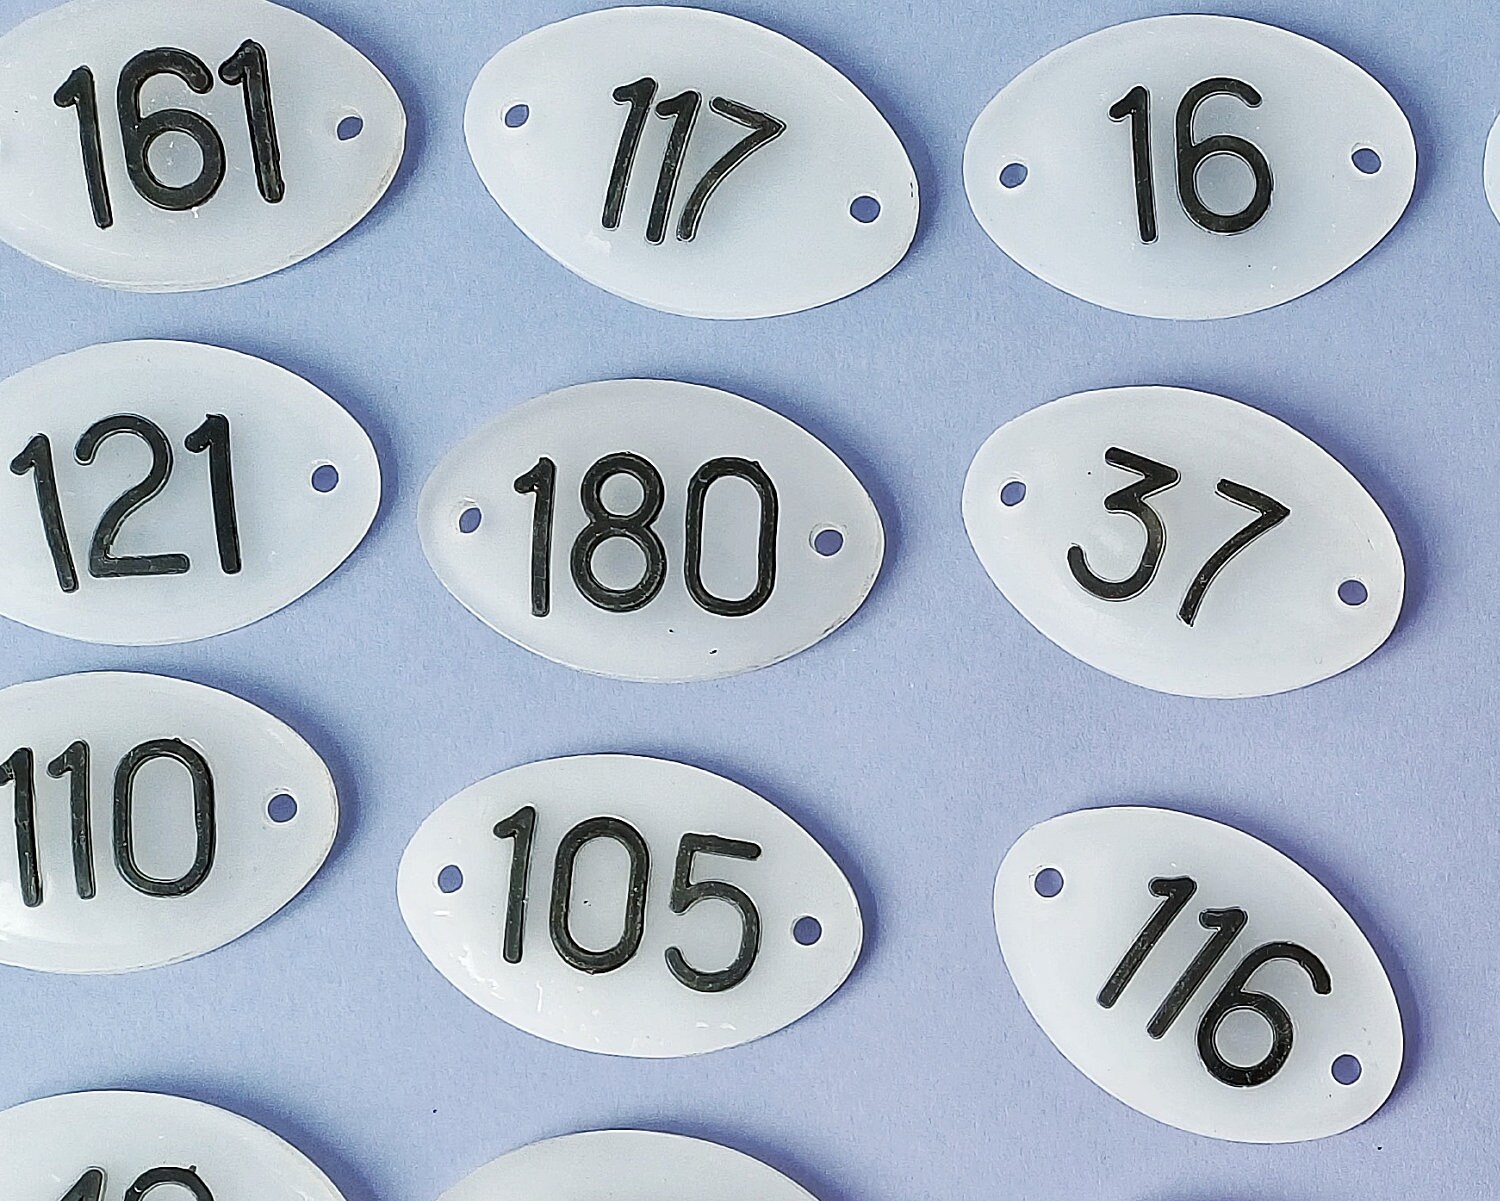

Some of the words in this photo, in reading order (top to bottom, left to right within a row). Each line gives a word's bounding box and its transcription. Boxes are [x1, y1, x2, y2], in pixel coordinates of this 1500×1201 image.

[54, 39, 285, 229] 161
[602, 78, 784, 244] 117
[1110, 78, 1273, 242] 16
[9, 414, 241, 592] 121
[514, 452, 779, 618] 180
[1068, 447, 1290, 626] 37
[0, 737, 216, 907] 110
[494, 805, 762, 993] 105
[1098, 876, 1332, 1089] 116
